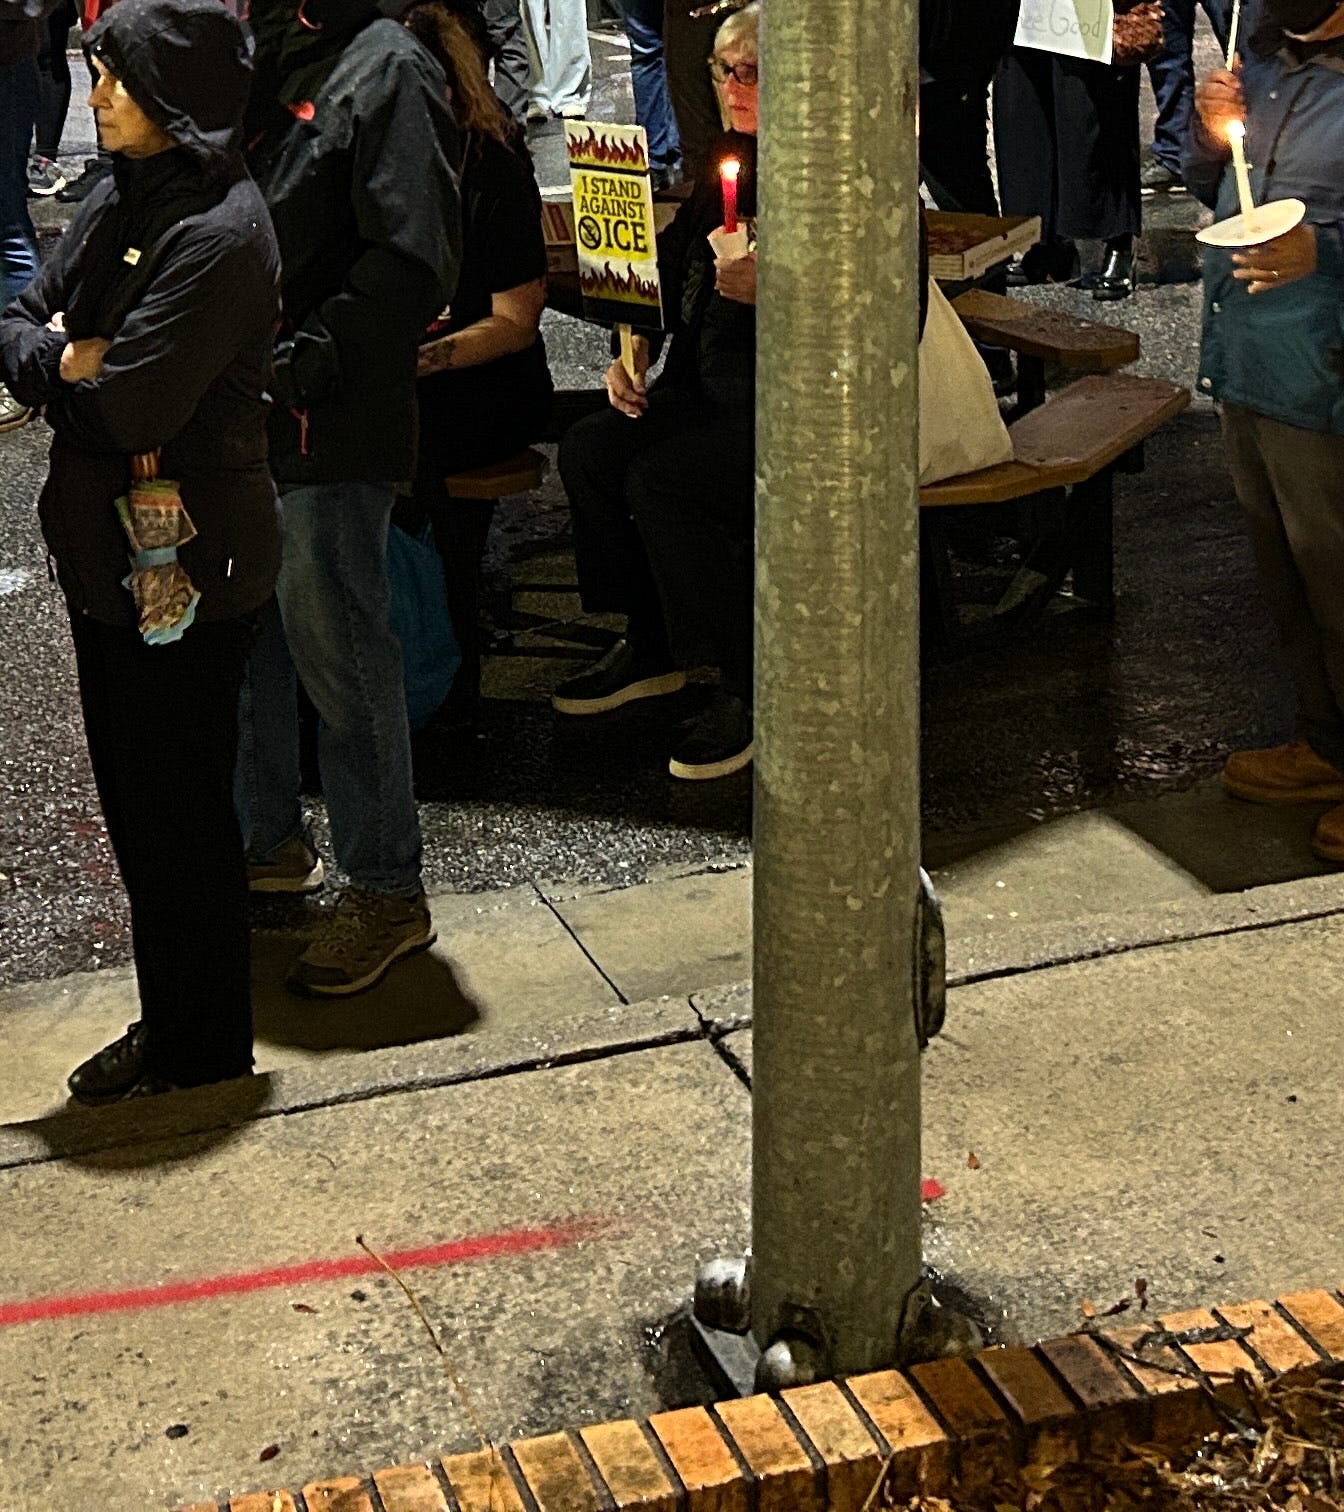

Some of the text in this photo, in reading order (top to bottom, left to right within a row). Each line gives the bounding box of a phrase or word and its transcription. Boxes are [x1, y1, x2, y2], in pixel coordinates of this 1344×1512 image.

[581, 175, 642, 200] I STAND
[580, 195, 646, 220] AGAINST
[603, 218, 649, 254] ICE
